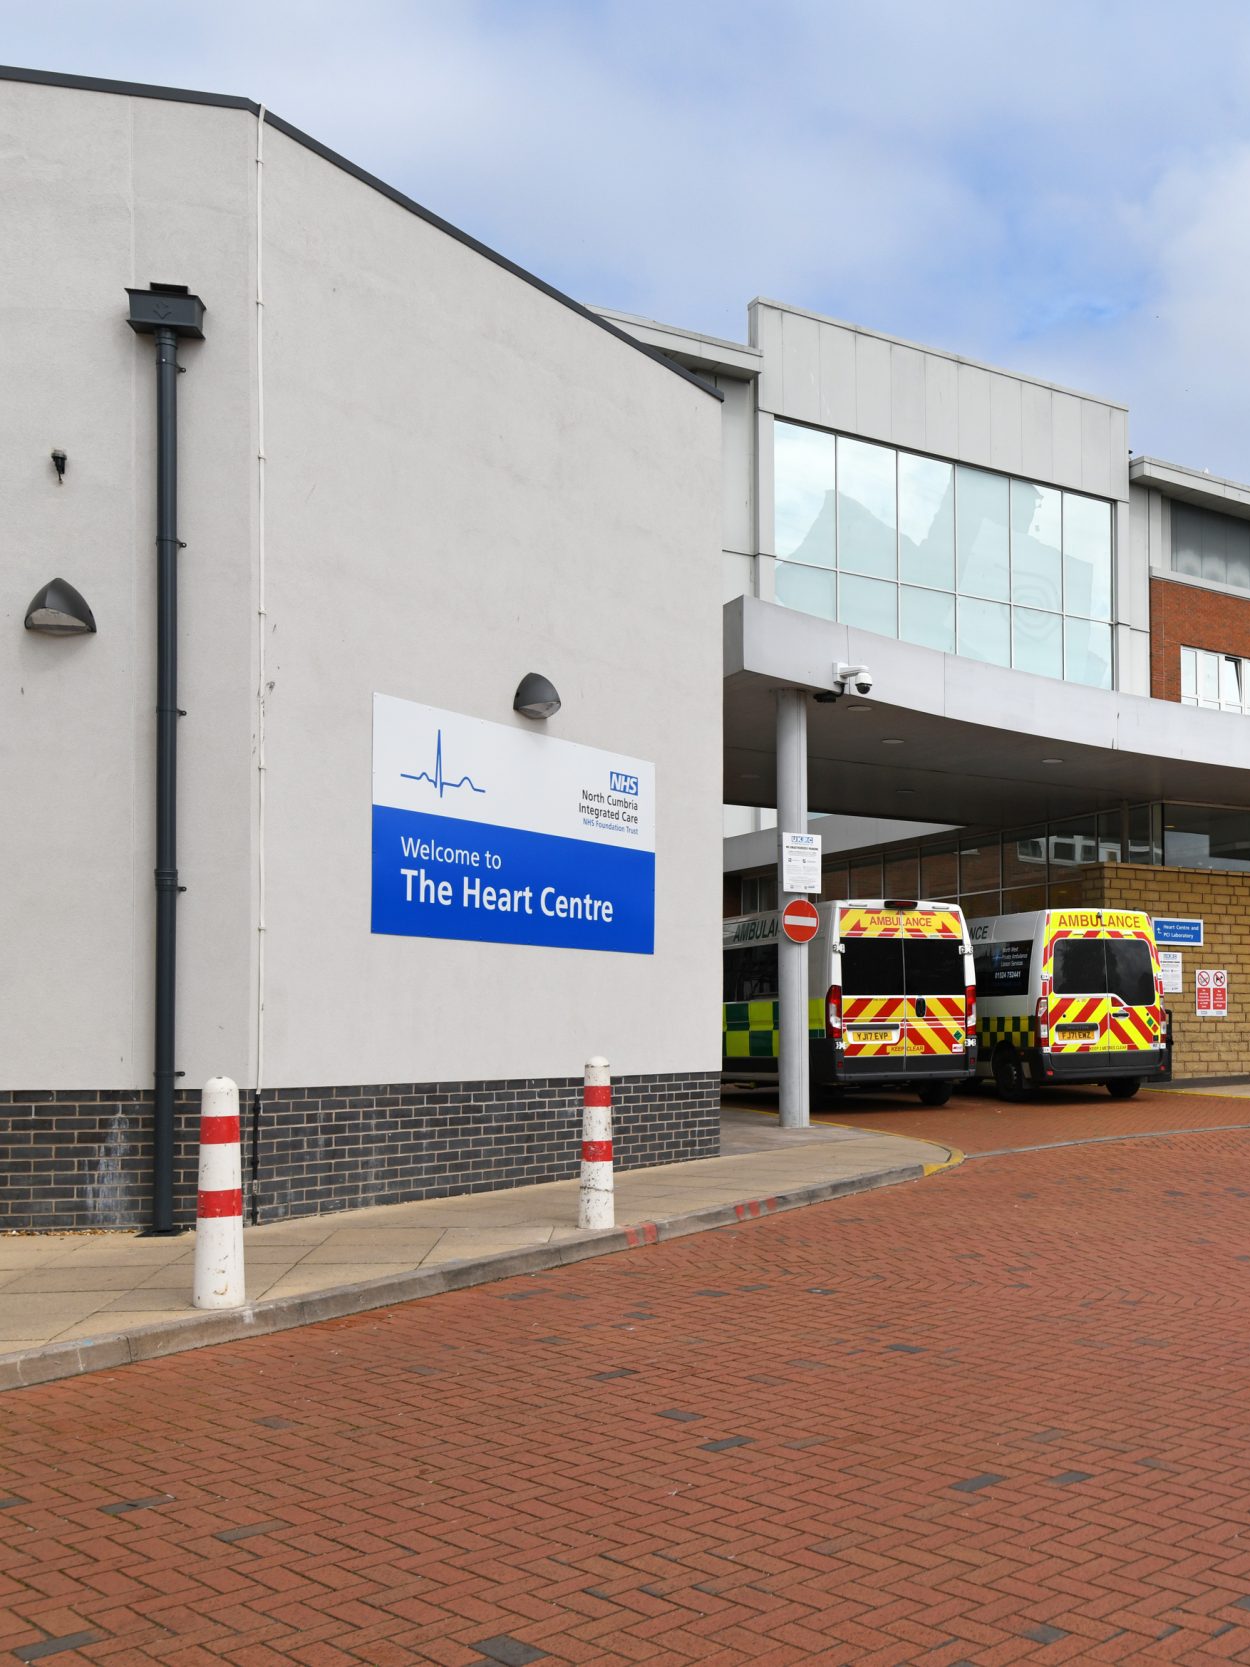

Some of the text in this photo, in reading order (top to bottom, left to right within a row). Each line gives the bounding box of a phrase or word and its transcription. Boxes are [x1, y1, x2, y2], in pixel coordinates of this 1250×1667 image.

[611, 772, 637, 794] NHS
[582, 789, 638, 811] North Cumbria
[579, 803, 638, 824] Integrated Care
[583, 818, 638, 835] NHS Foundation Trust
[400, 836, 502, 870] Welcome to
[400, 868, 614, 923] The Heart Centre
[733, 917, 779, 942] AMBULA
[1058, 914, 1141, 928] AMBULANCE
[856, 1032, 889, 1041] YJ17 EVP
[1062, 1031, 1091, 1040] FJ71 EWZ
